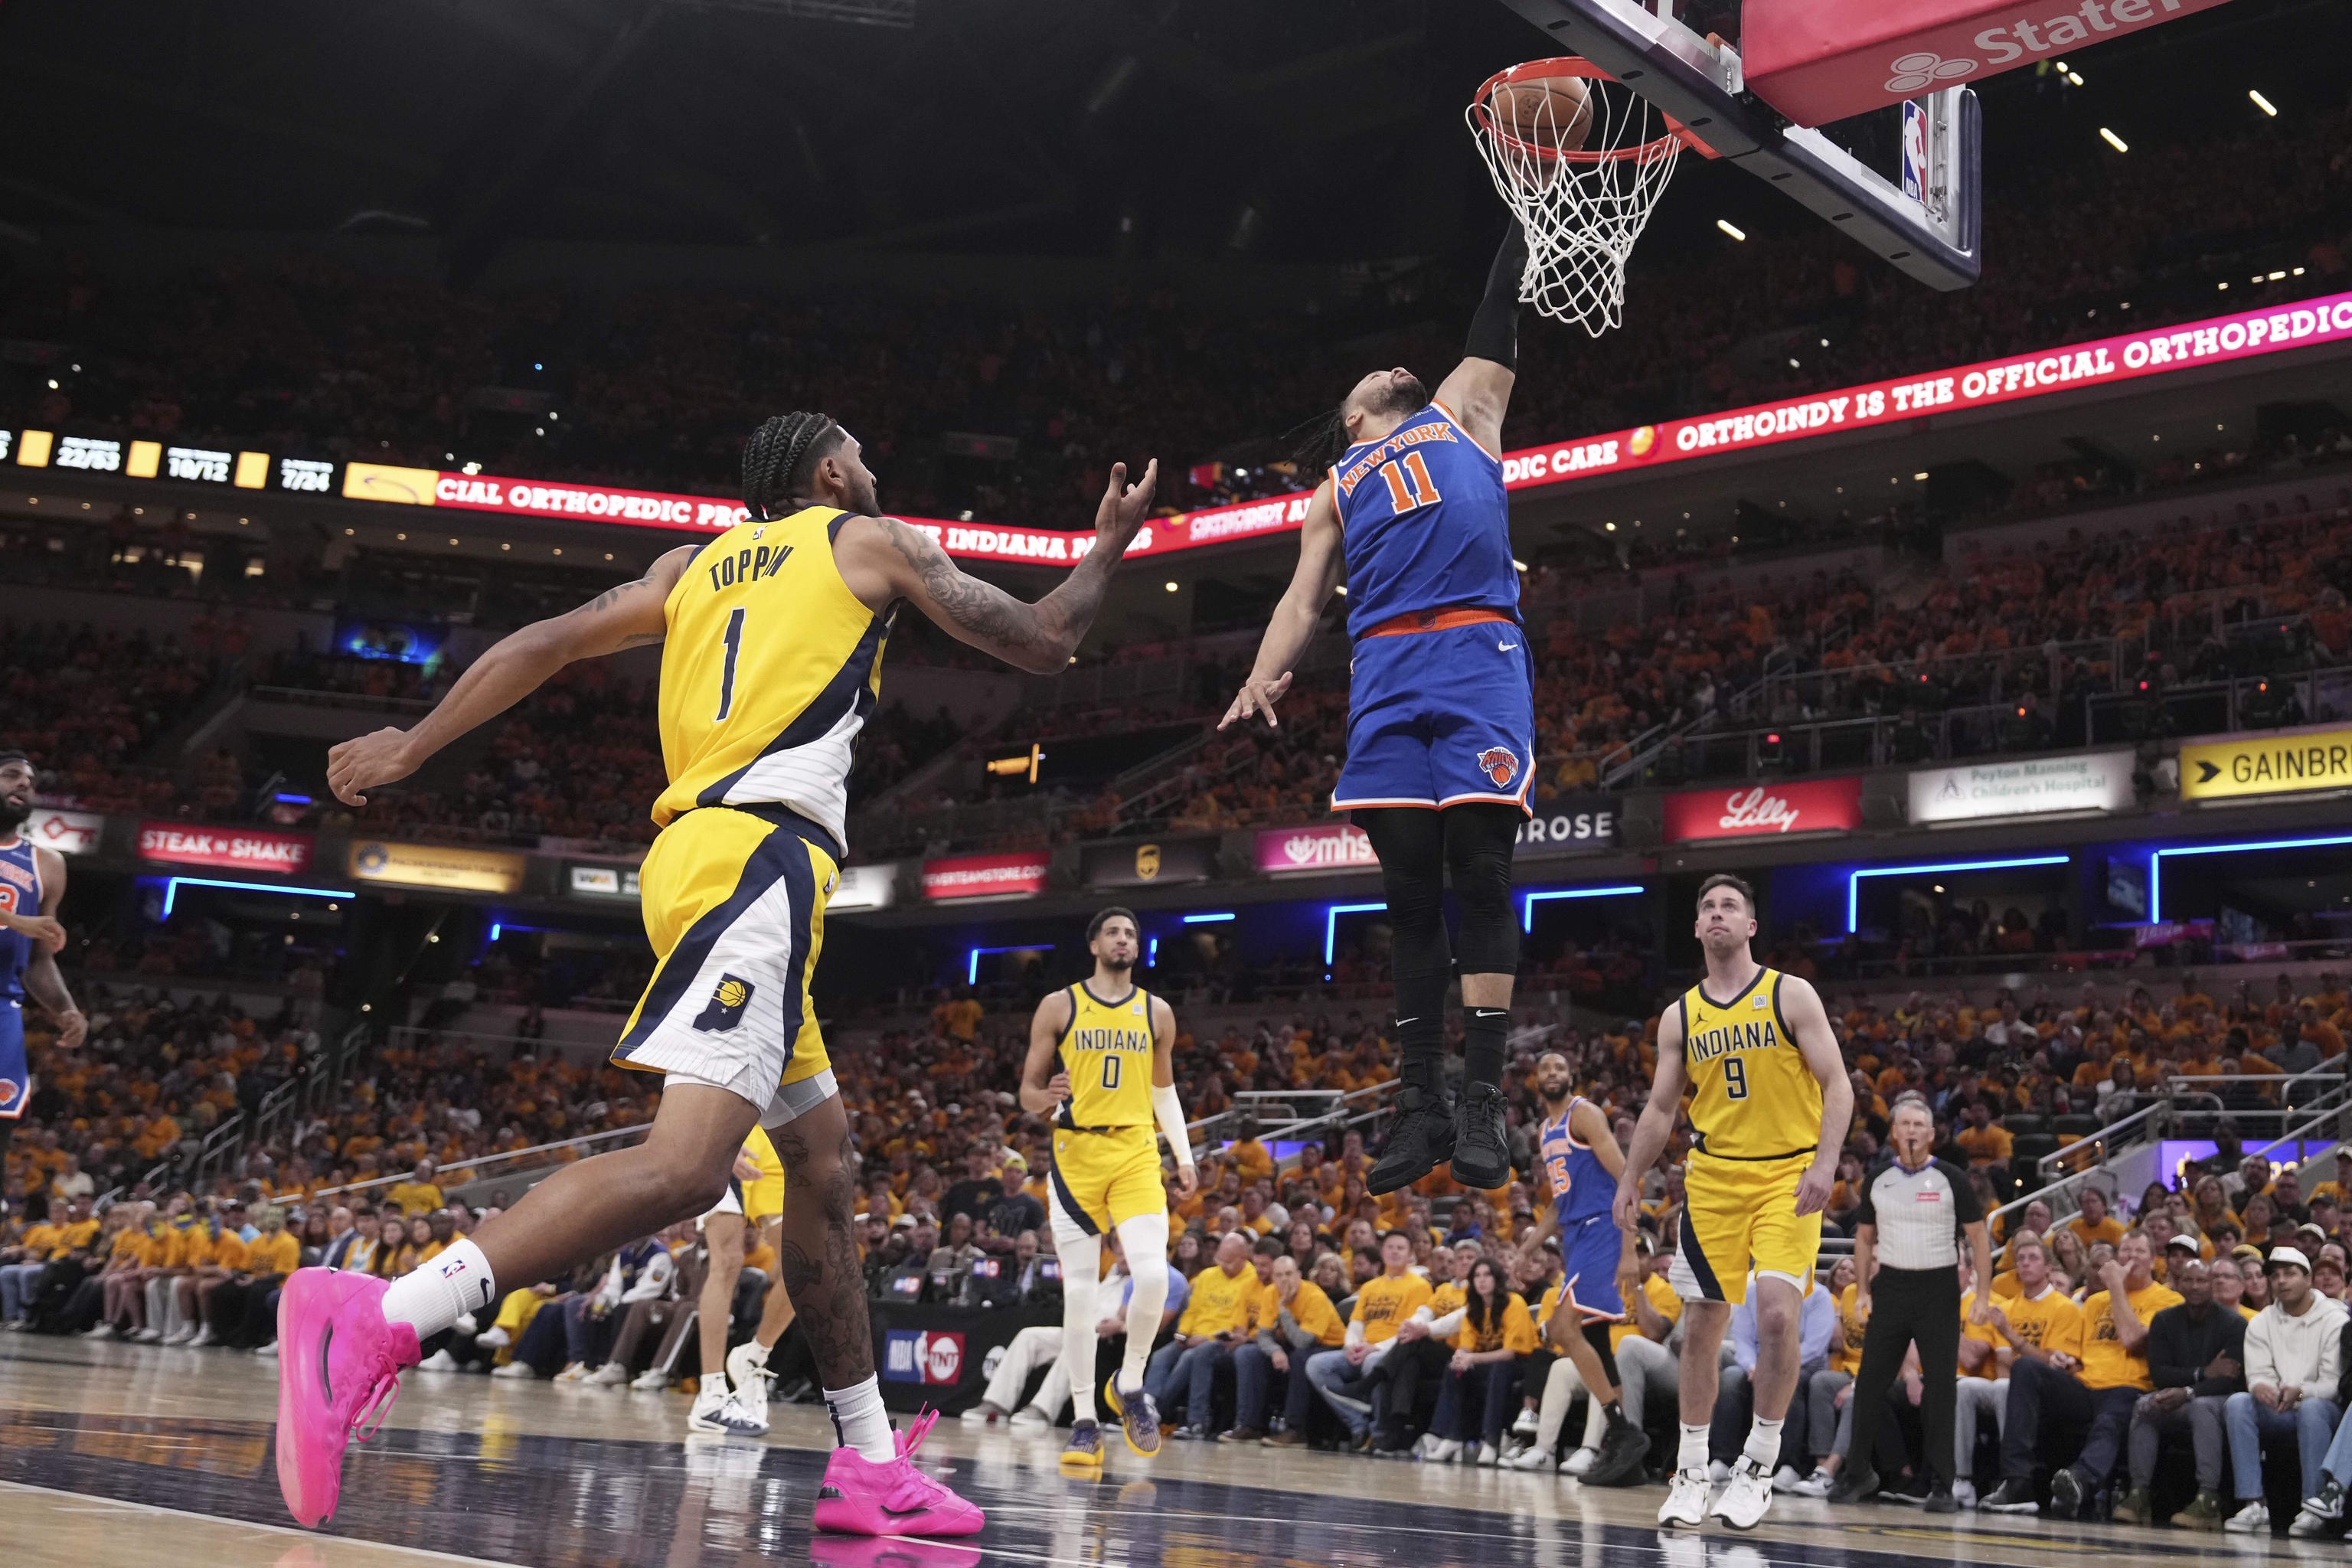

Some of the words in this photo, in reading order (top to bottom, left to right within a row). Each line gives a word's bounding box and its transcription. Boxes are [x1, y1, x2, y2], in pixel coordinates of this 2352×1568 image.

[1906, 176, 1917, 200] NBA
[1676, 397, 1848, 452] ORTHOINDY
[1855, 391, 1884, 419] IS
[1892, 377, 1954, 411] THE
[1962, 348, 2115, 399] OFFICIAL
[2123, 301, 2352, 369] ORTHOPEDIC
[168, 457, 229, 482] 10/12
[1340, 446, 1390, 498] NEW
[1387, 421, 1459, 453] YORK
[1551, 440, 1619, 473] CARE
[280, 468, 331, 492] 7/24
[1378, 449, 1442, 515] 11
[508, 485, 691, 523] ORTHOPEDIC
[946, 527, 1067, 559] INDIANA
[708, 545, 794, 592] TOPPIN
[712, 606, 746, 723] 1
[1481, 751, 1517, 769] KNICKS
[1971, 766, 2020, 782] Peyton
[2024, 760, 2088, 776] Manning
[1971, 780, 2040, 799] Children's
[2044, 774, 2106, 794] Hospital
[1719, 786, 1799, 833] Lilly
[142, 829, 213, 854] STEAK
[230, 838, 305, 863] SHAKE
[1317, 828, 1373, 862] mhs
[1073, 1028, 1148, 1054] INDIANA
[1689, 1019, 1779, 1063] INDIANA
[1101, 1054, 1123, 1091] 0
[1723, 1056, 1749, 1101] 9
